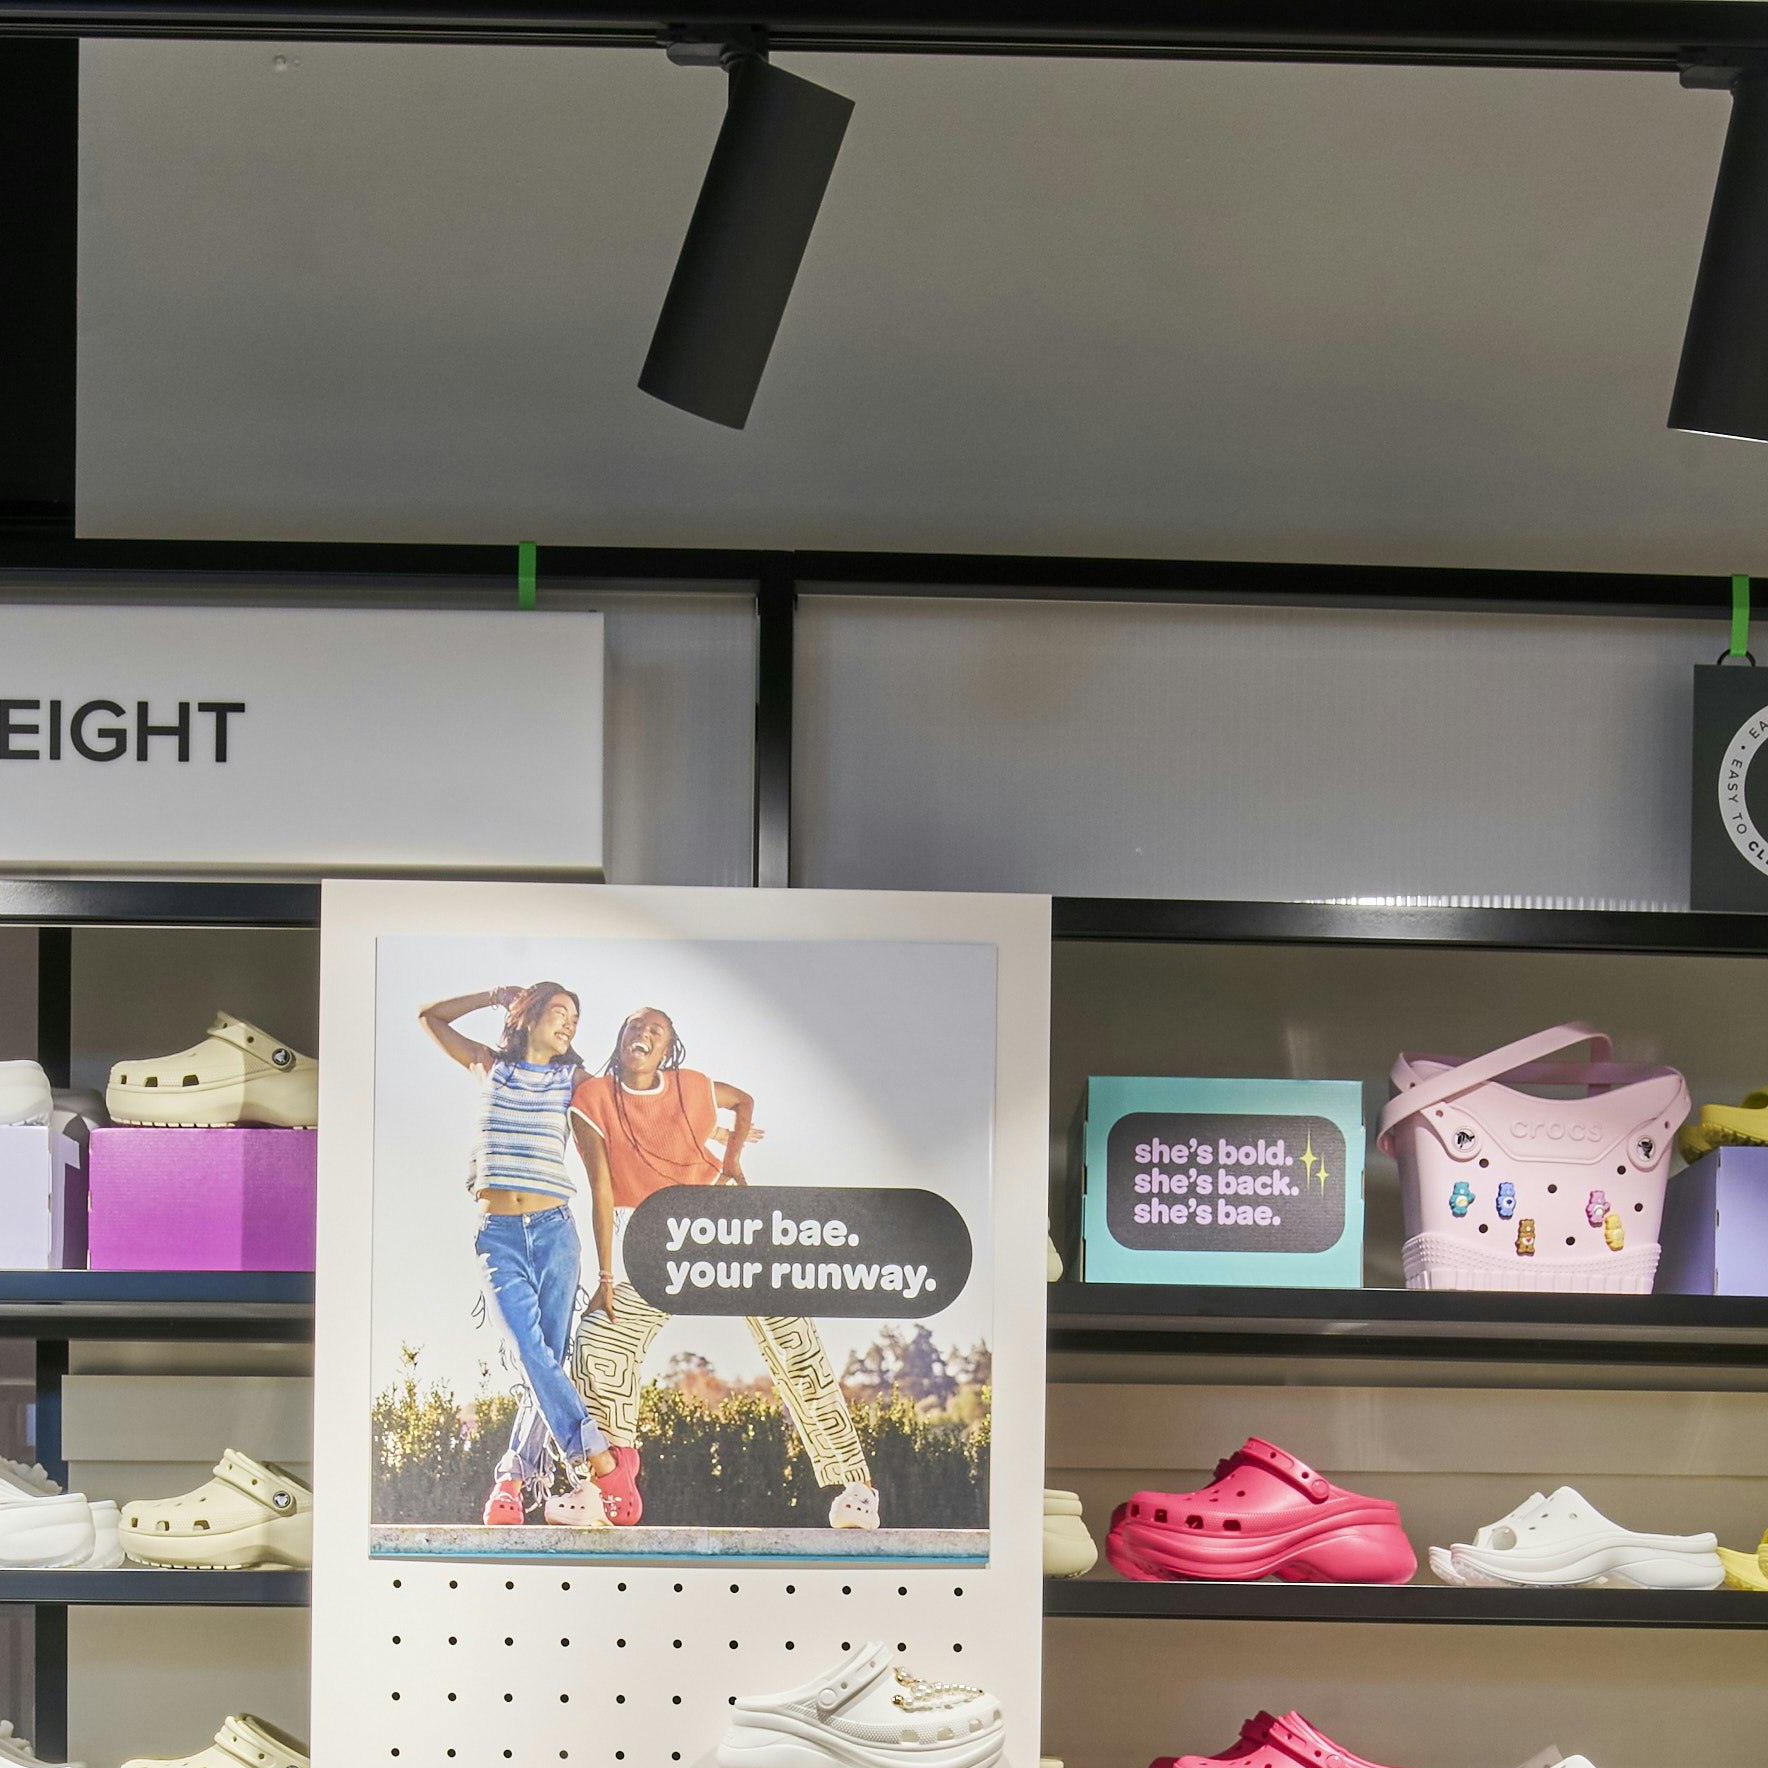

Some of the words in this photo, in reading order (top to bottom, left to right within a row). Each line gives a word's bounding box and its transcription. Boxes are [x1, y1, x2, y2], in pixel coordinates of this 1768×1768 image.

[1727, 759, 1744, 803] EASY
[1731, 812, 1748, 835] TO
[1509, 1116, 1603, 1144] crocs
[1134, 1138, 1213, 1164] she's
[1217, 1138, 1293, 1166] bold.
[1133, 1170, 1213, 1195] she's
[1217, 1169, 1300, 1196] back.
[1133, 1200, 1213, 1226] she's
[1217, 1200, 1282, 1227] bae.
[665, 1217, 763, 1254] your
[771, 1210, 859, 1249] bae.
[665, 1260, 763, 1297] your
[771, 1261, 938, 1300] runway.
